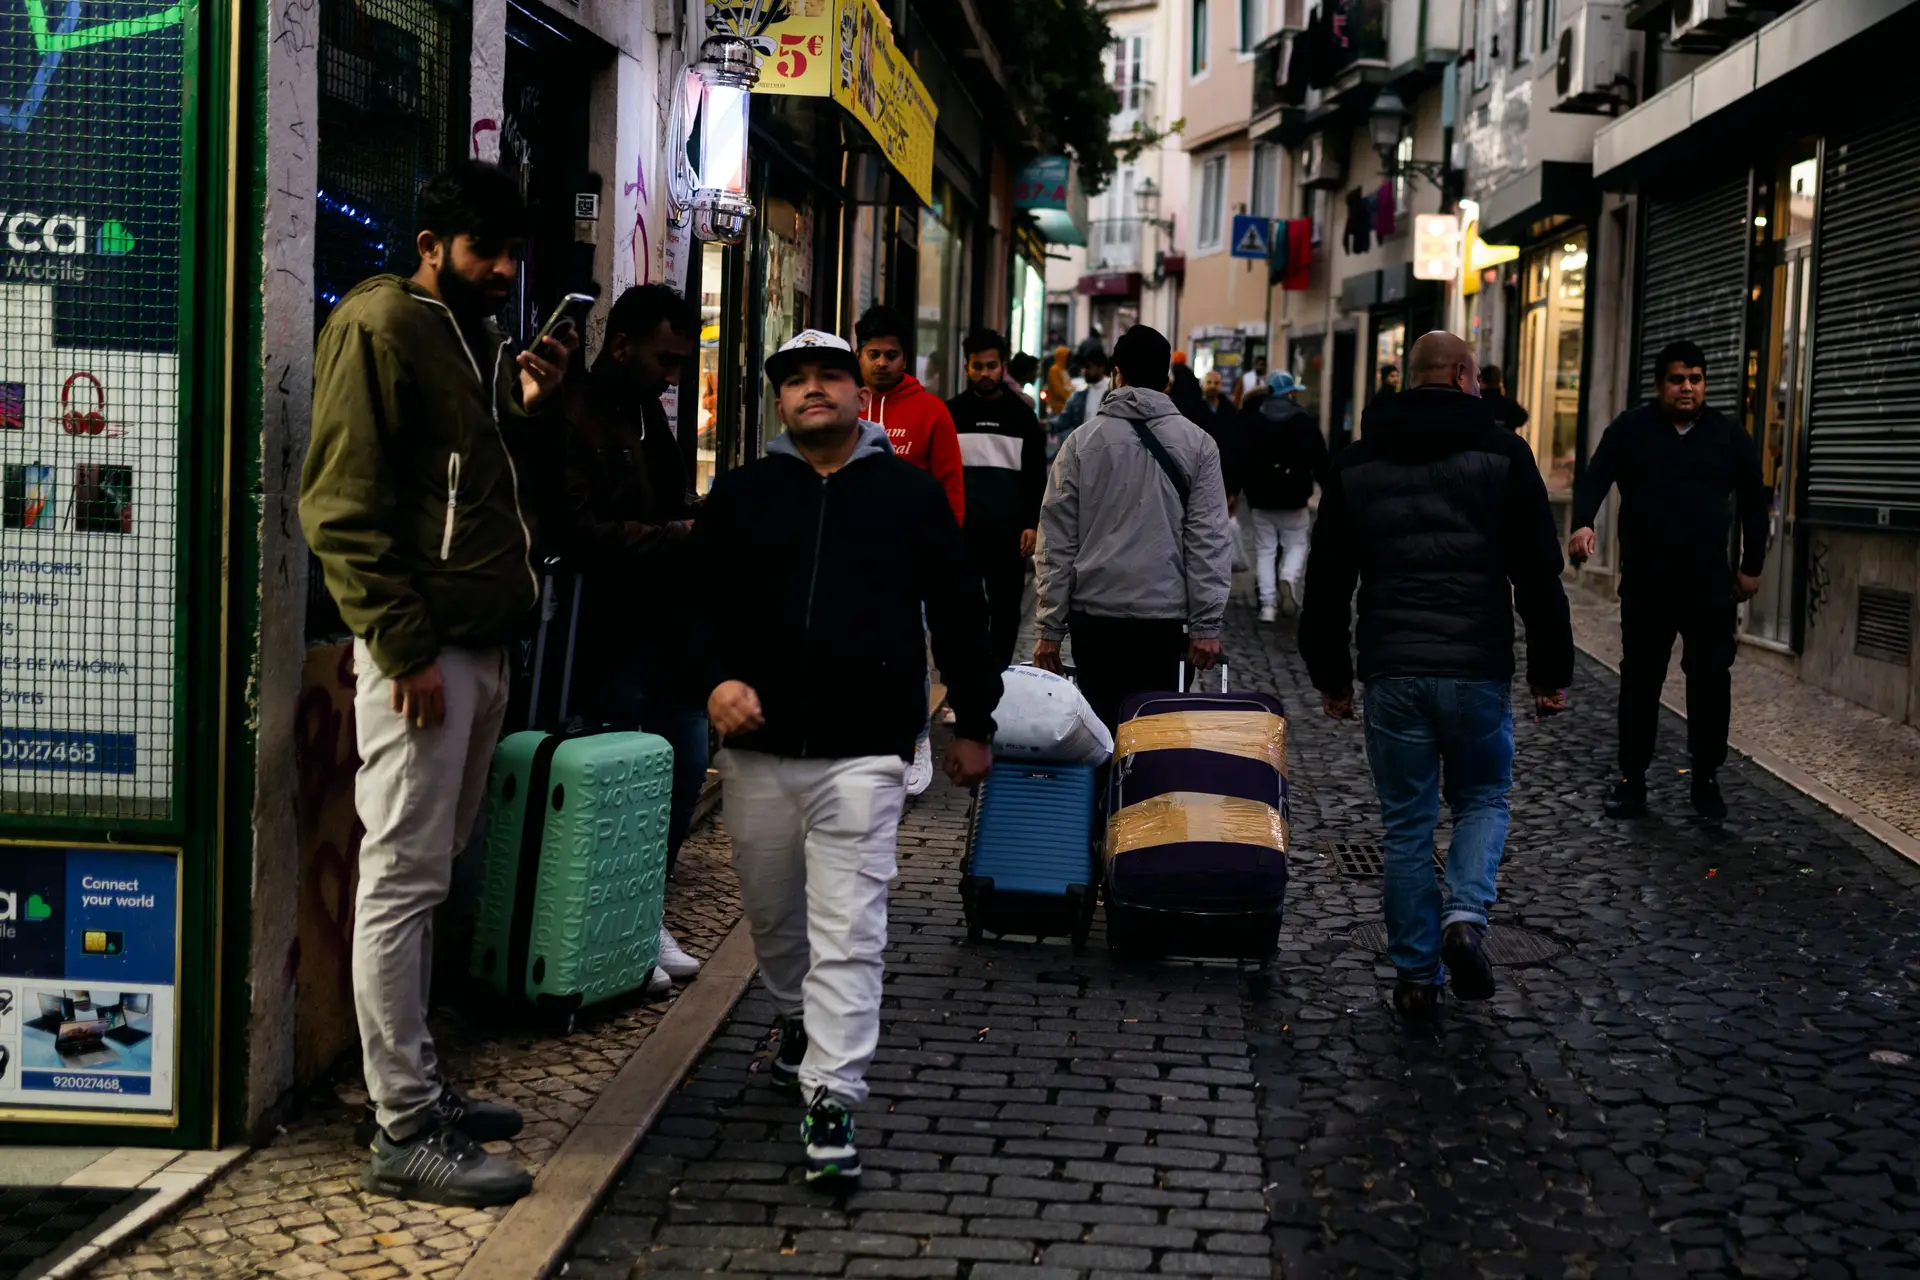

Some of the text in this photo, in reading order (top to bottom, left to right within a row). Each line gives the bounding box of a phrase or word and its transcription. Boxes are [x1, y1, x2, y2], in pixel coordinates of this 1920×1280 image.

[0, 212, 86, 254] ca
[7, 257, 85, 281] Mobile
[26, 658, 46, 671] DE
[596, 776, 671, 810] MONTREAL
[591, 803, 668, 853] PARIS
[81, 876, 140, 892] Connect
[81, 894, 155, 909] your world
[533, 810, 565, 956] MARRAKECH
[556, 788, 597, 986] AMSTERDAM
[586, 867, 664, 907] BANGKOK
[581, 894, 663, 949] MILAN
